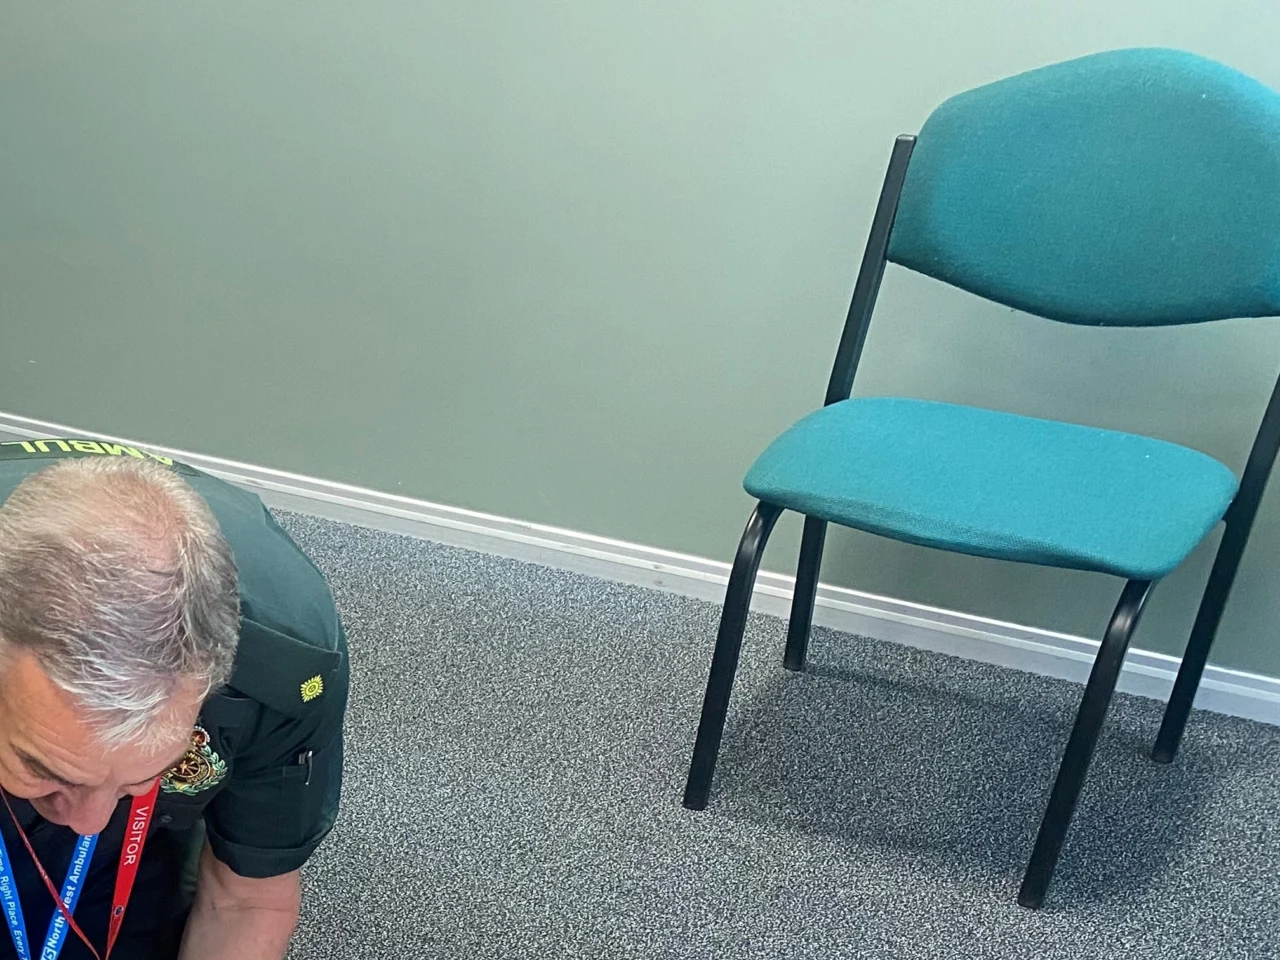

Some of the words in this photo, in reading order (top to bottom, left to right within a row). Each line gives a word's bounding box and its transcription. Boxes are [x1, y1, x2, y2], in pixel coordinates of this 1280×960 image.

[123, 806, 151, 866] VISITOR
[0, 875, 14, 901] Right
[5, 901, 19, 928] Place,
[13, 929, 26, 957] Every
[47, 915, 66, 950] North
